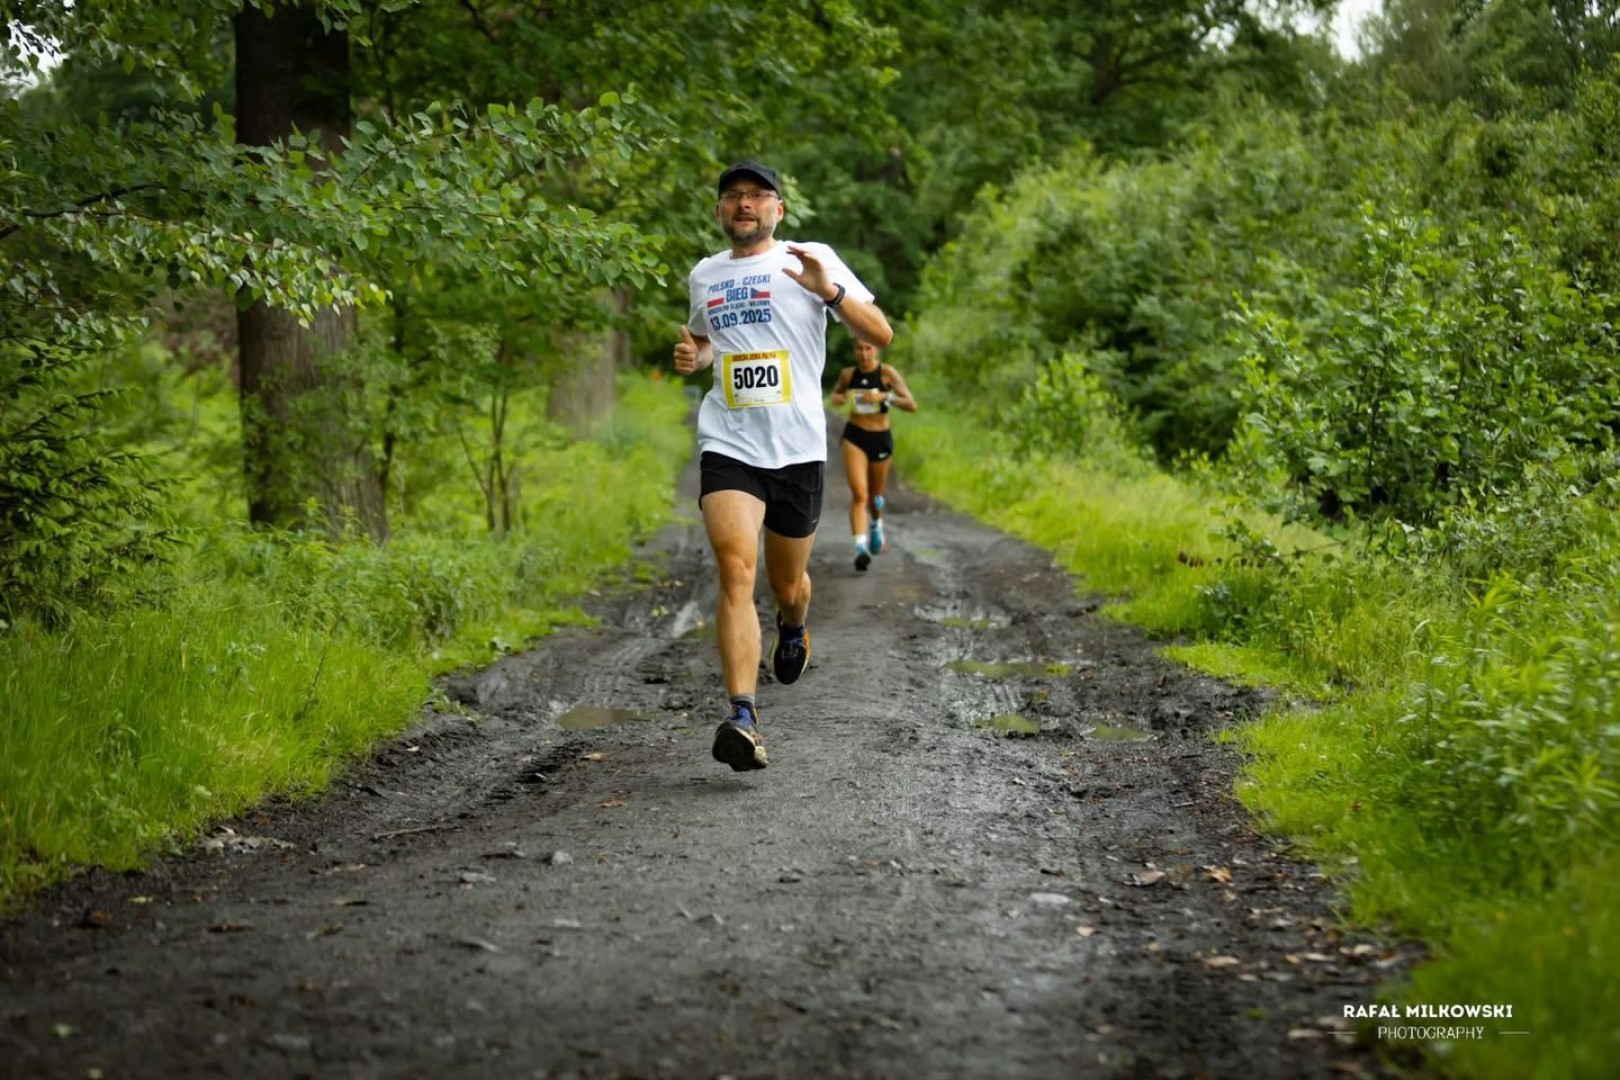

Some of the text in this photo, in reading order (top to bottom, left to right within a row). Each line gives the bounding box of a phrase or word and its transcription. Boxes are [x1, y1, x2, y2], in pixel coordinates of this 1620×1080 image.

[708, 279, 735, 295] POLSKO
[743, 274, 771, 286] CZESKI
[726, 287, 748, 302] BIEG
[710, 309, 772, 331] 13.09.2025
[734, 365, 778, 389] 5020
